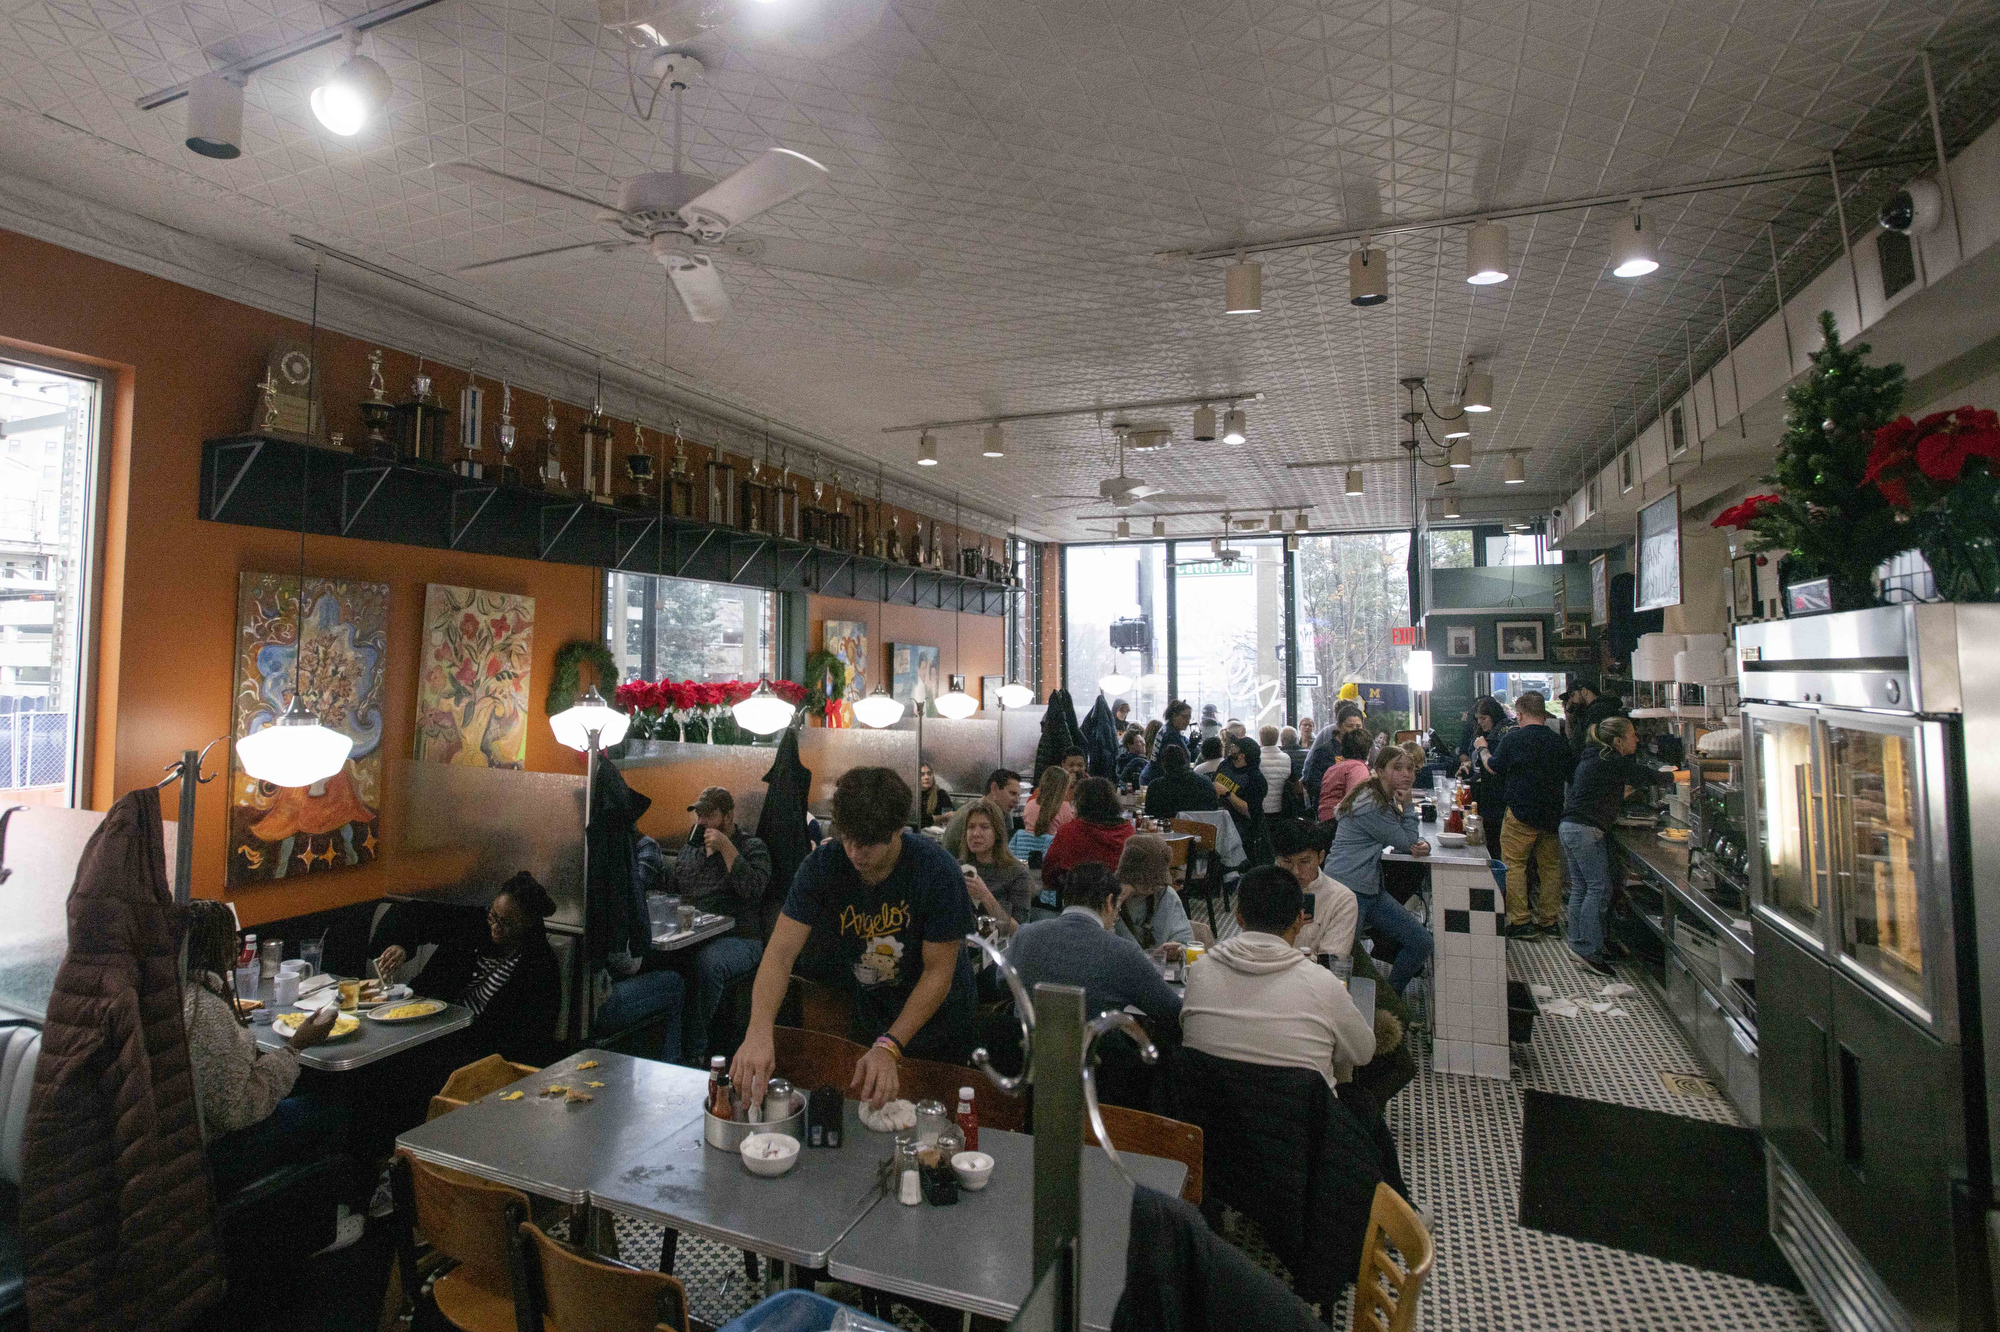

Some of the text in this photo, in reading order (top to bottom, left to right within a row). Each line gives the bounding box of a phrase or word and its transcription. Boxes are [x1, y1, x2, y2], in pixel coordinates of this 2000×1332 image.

[1392, 627, 1416, 645] EXIT
[1369, 688, 1381, 698] M
[840, 900, 911, 940] Angelo's
